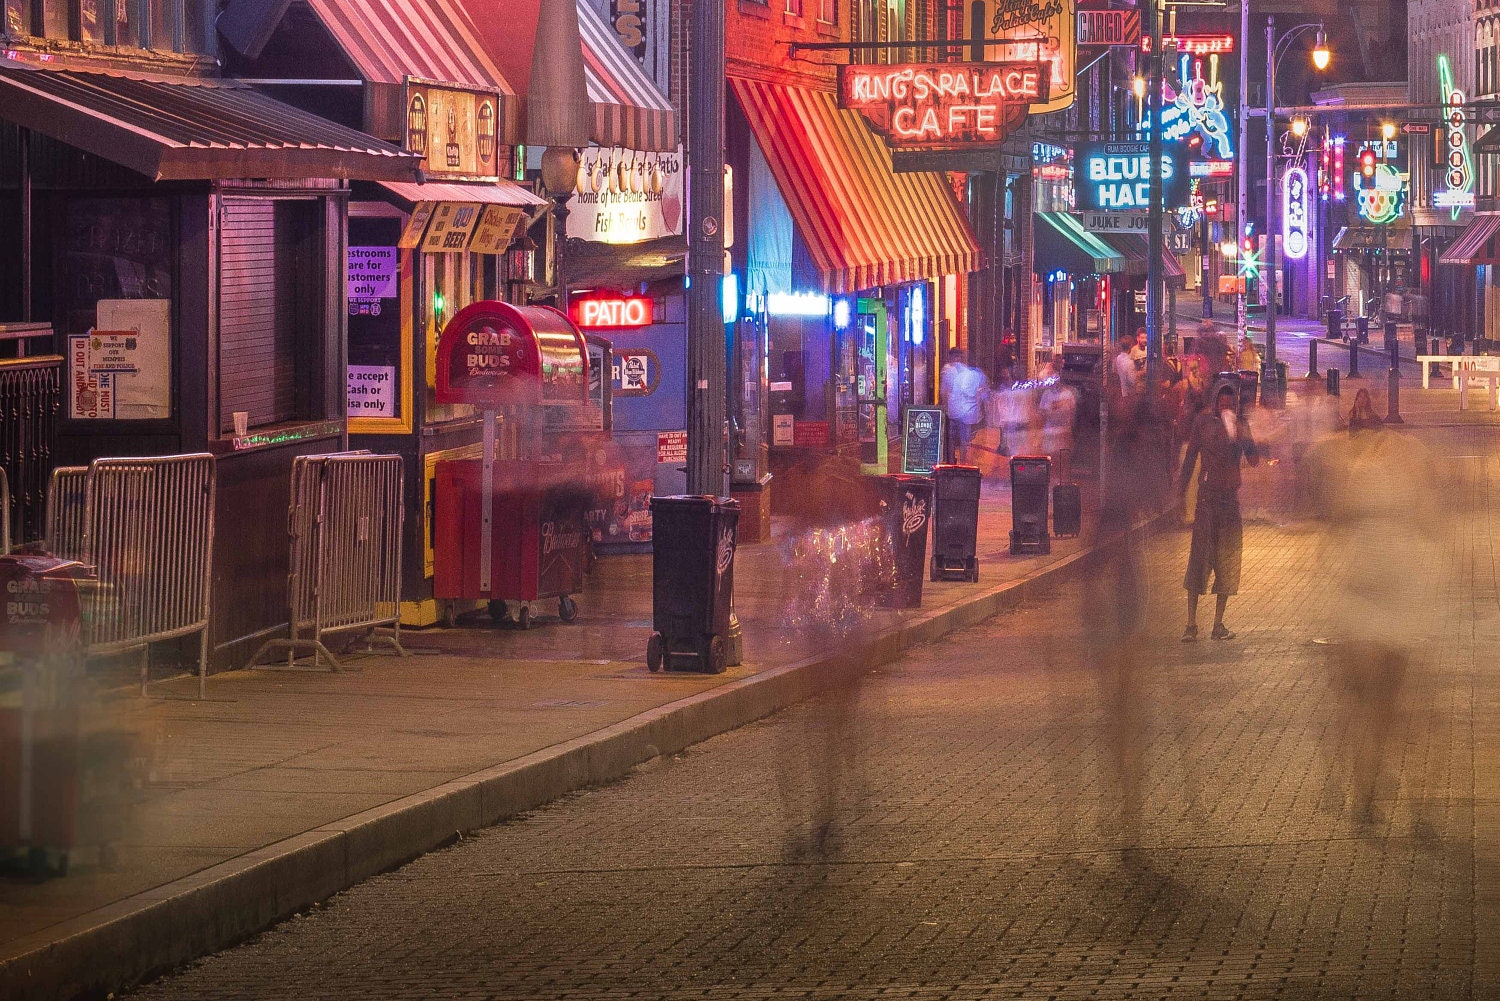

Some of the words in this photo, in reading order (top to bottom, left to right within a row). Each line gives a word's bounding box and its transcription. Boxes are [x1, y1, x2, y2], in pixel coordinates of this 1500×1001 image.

[1078, 11, 1122, 43] CARGO
[937, 71, 1038, 98] PALACE
[893, 104, 999, 137] CAFE
[1107, 145, 1118, 153] RUM
[1118, 145, 1139, 153] BOOGIE
[1139, 145, 1150, 153] CAF
[1089, 155, 1174, 181] BLUES
[1098, 183, 1165, 206] HAL
[1089, 216, 1120, 230] JUKE
[443, 231, 467, 248] BEER
[347, 249, 391, 258] estrooms
[348, 262, 364, 270] are
[367, 260, 382, 270] for
[354, 283, 376, 296] only
[584, 299, 644, 326] PATIO
[467, 332, 512, 346] GRAB
[75, 351, 85, 368] OUT
[467, 354, 510, 368] BUDS
[356, 372, 389, 383] accept
[370, 386, 382, 395] or
[101, 390, 110, 412] MUST
[347, 398, 361, 408] isa
[363, 398, 386, 411] only
[6, 601, 50, 616] BUDS
